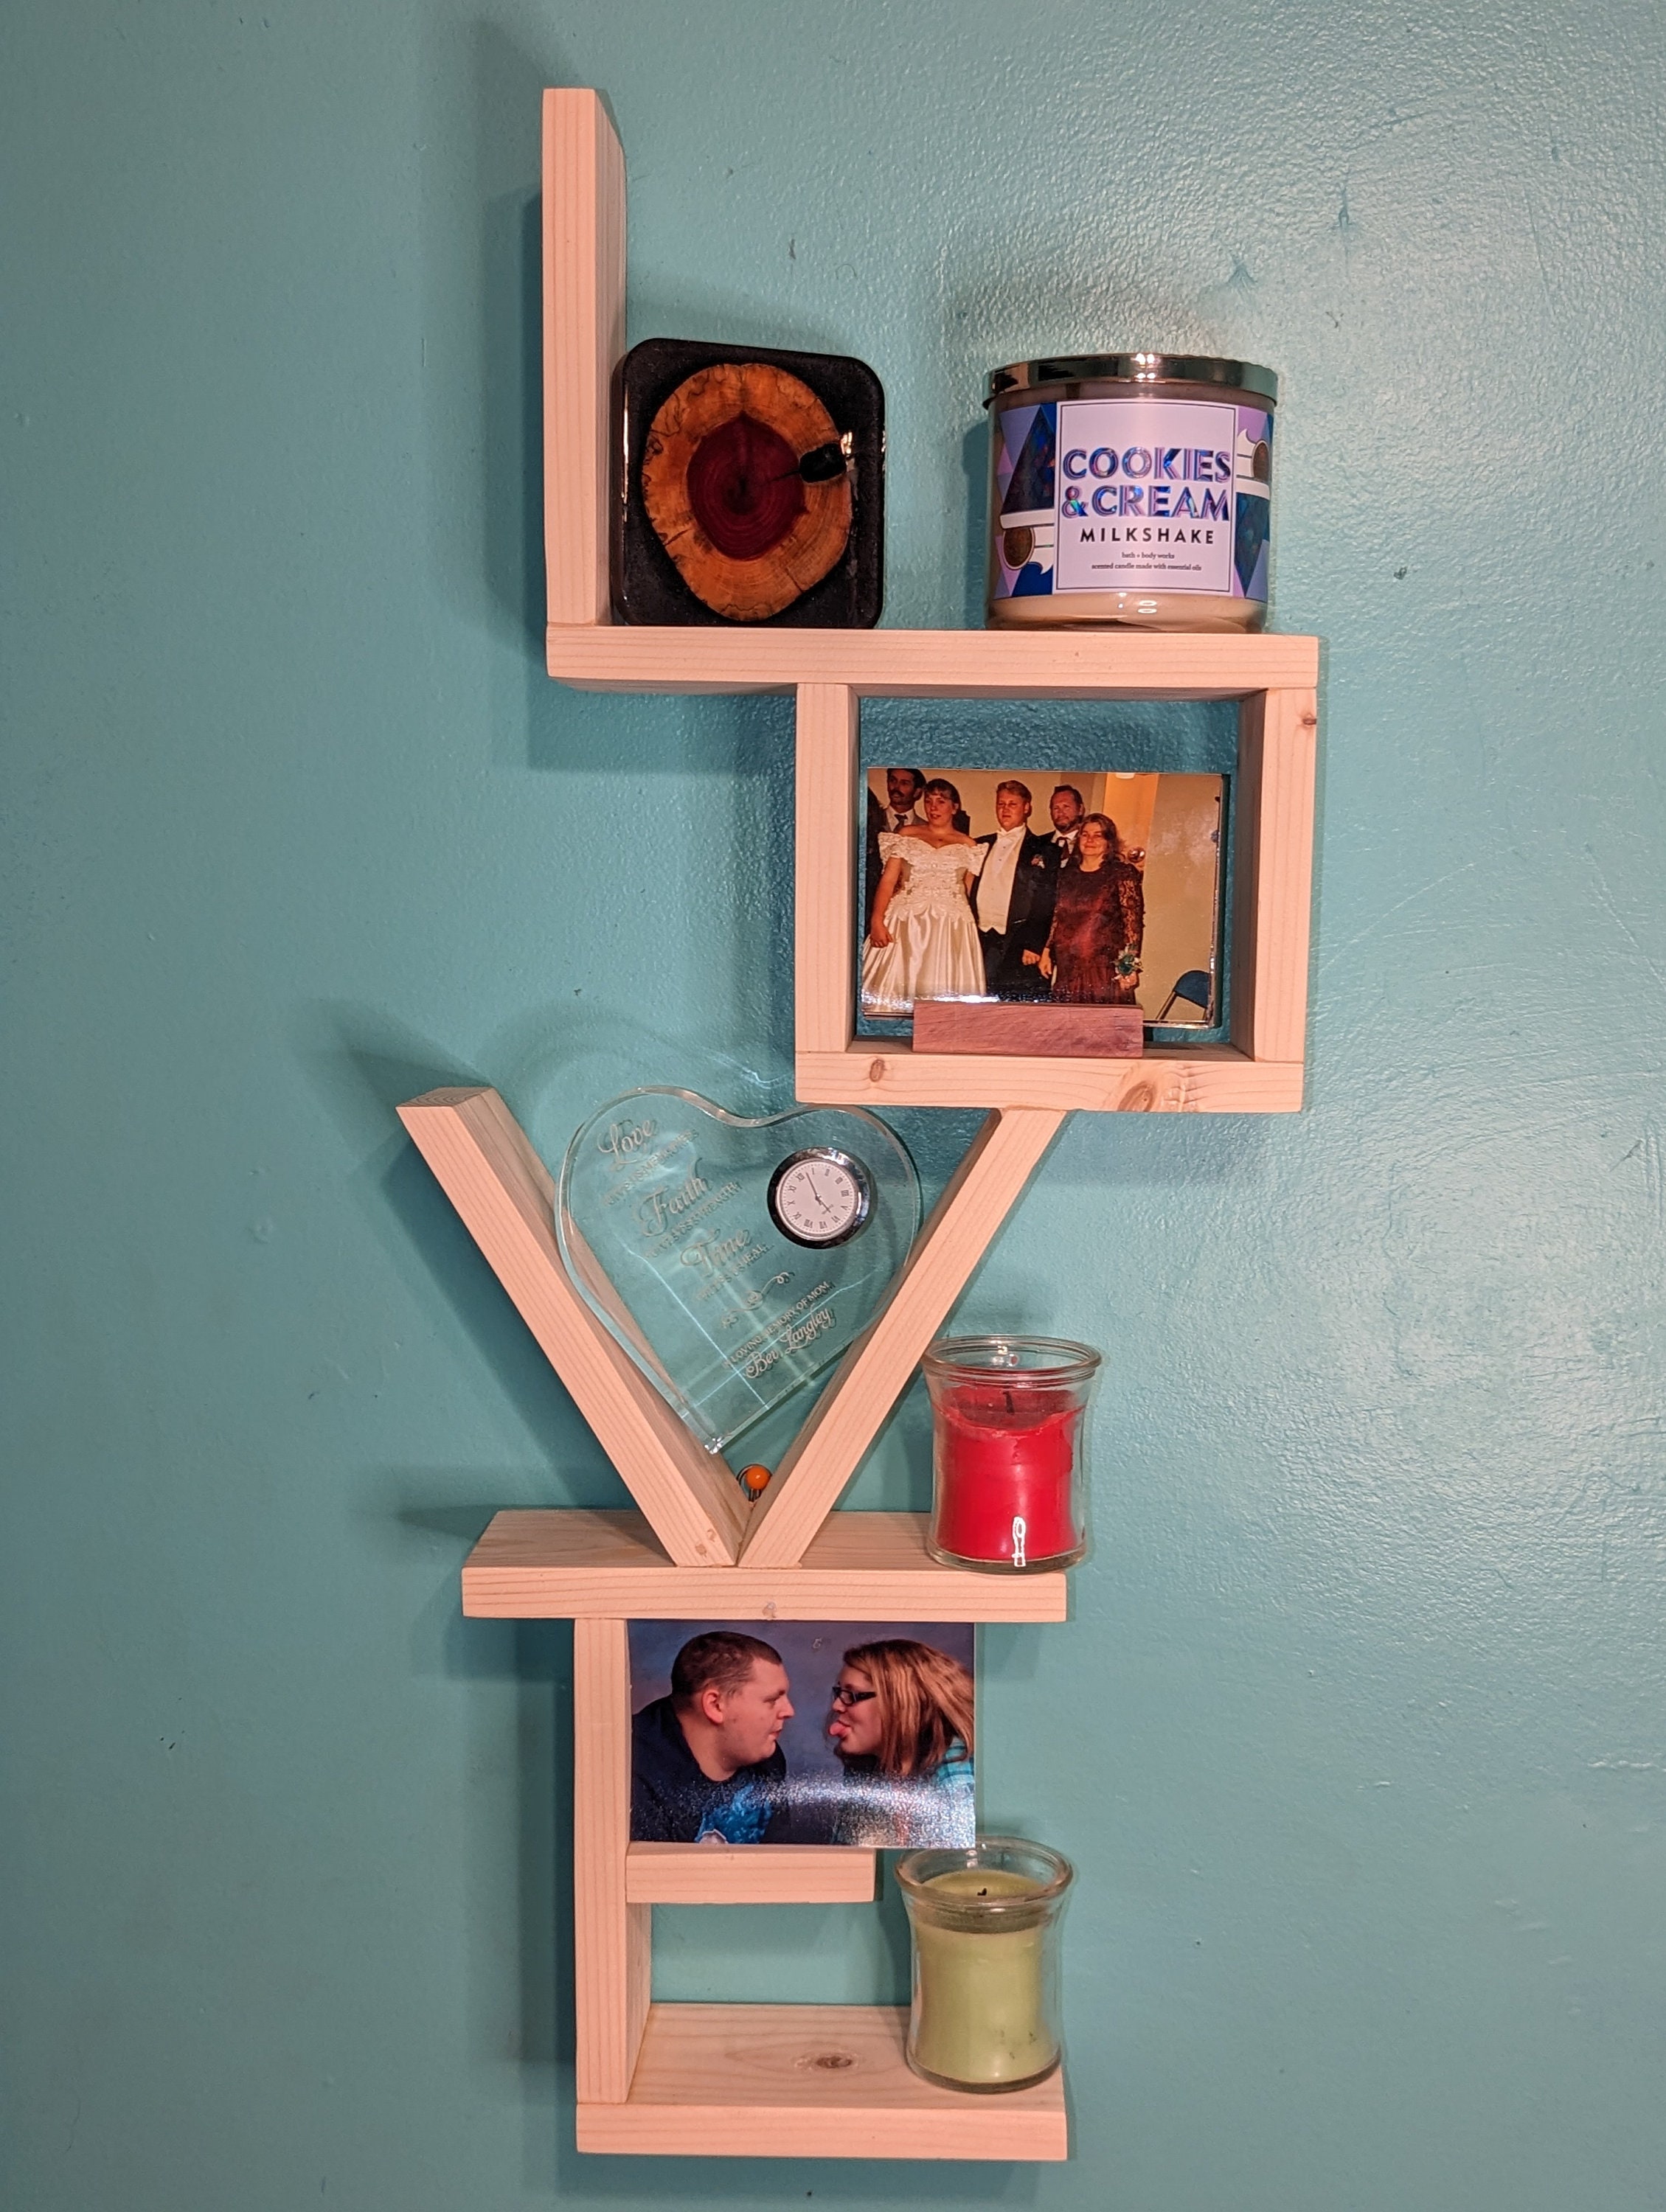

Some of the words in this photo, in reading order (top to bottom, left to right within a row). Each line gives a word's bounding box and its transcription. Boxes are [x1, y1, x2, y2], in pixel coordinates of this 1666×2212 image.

[1063, 447, 1231, 482] COOKIES
[1080, 527, 1214, 544] MILKSHAKE
[599, 1120, 655, 1171] Love
[635, 1158, 709, 1234] Faith
[680, 1228, 749, 1276] Time
[729, 1334, 763, 1363] LOVING
[795, 1297, 808, 1311] OF
[806, 1281, 830, 1301] MOM
[778, 1304, 830, 1353] Langley
